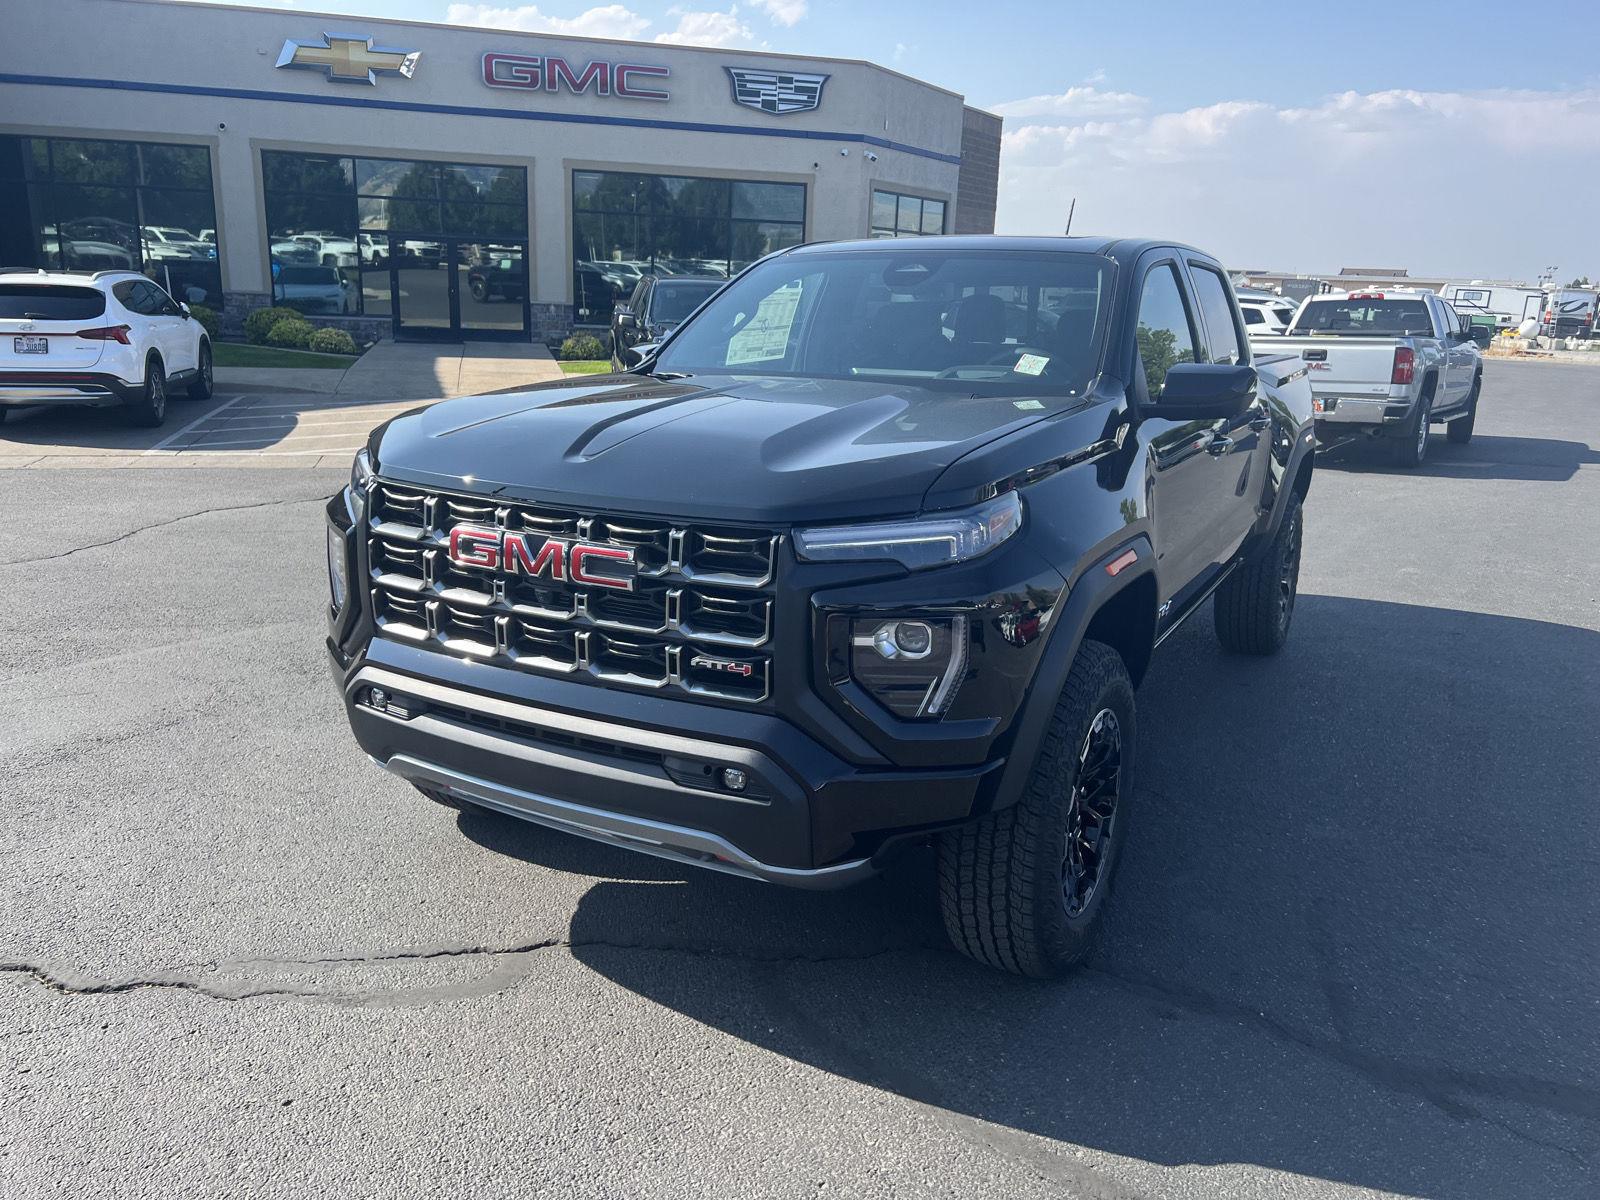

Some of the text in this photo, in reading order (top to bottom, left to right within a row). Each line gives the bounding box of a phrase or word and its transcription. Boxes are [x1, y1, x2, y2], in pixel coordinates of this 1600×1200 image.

[481, 52, 670, 101] GMC
[1305, 362, 1332, 371] MC
[449, 522, 635, 592] GMC
[690, 656, 752, 677] AT4
